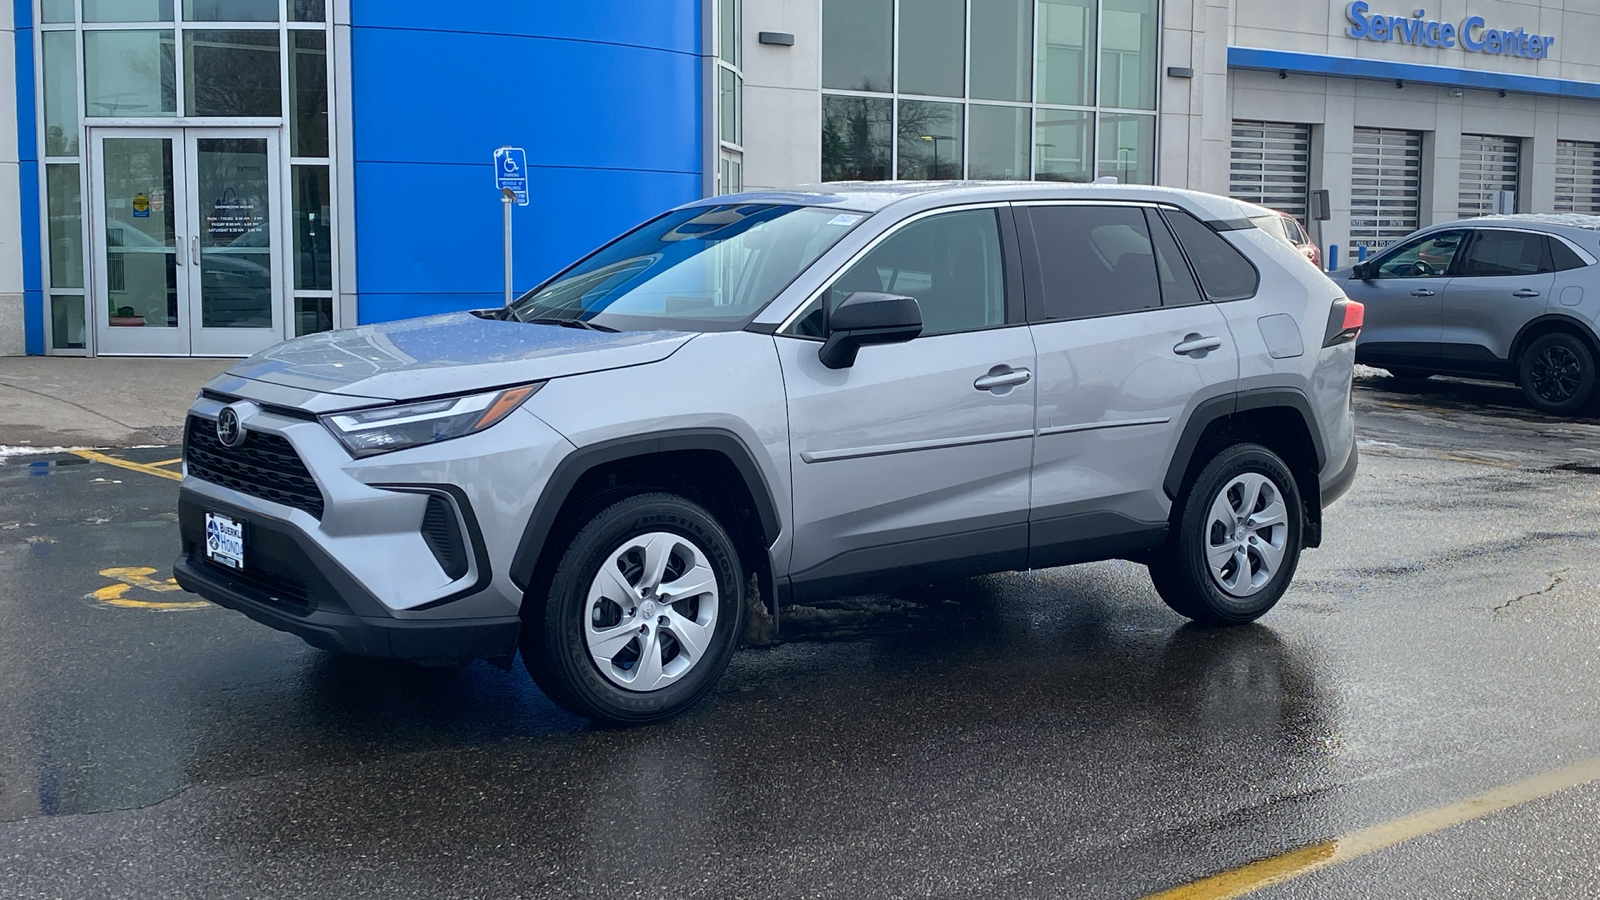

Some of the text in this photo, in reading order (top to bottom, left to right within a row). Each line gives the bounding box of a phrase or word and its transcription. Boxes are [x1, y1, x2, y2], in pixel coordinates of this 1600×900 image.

[1346, 0, 1555, 58] Service Center
[220, 522, 241, 539] BUERKL
[641, 513, 734, 588] DESTINATION
